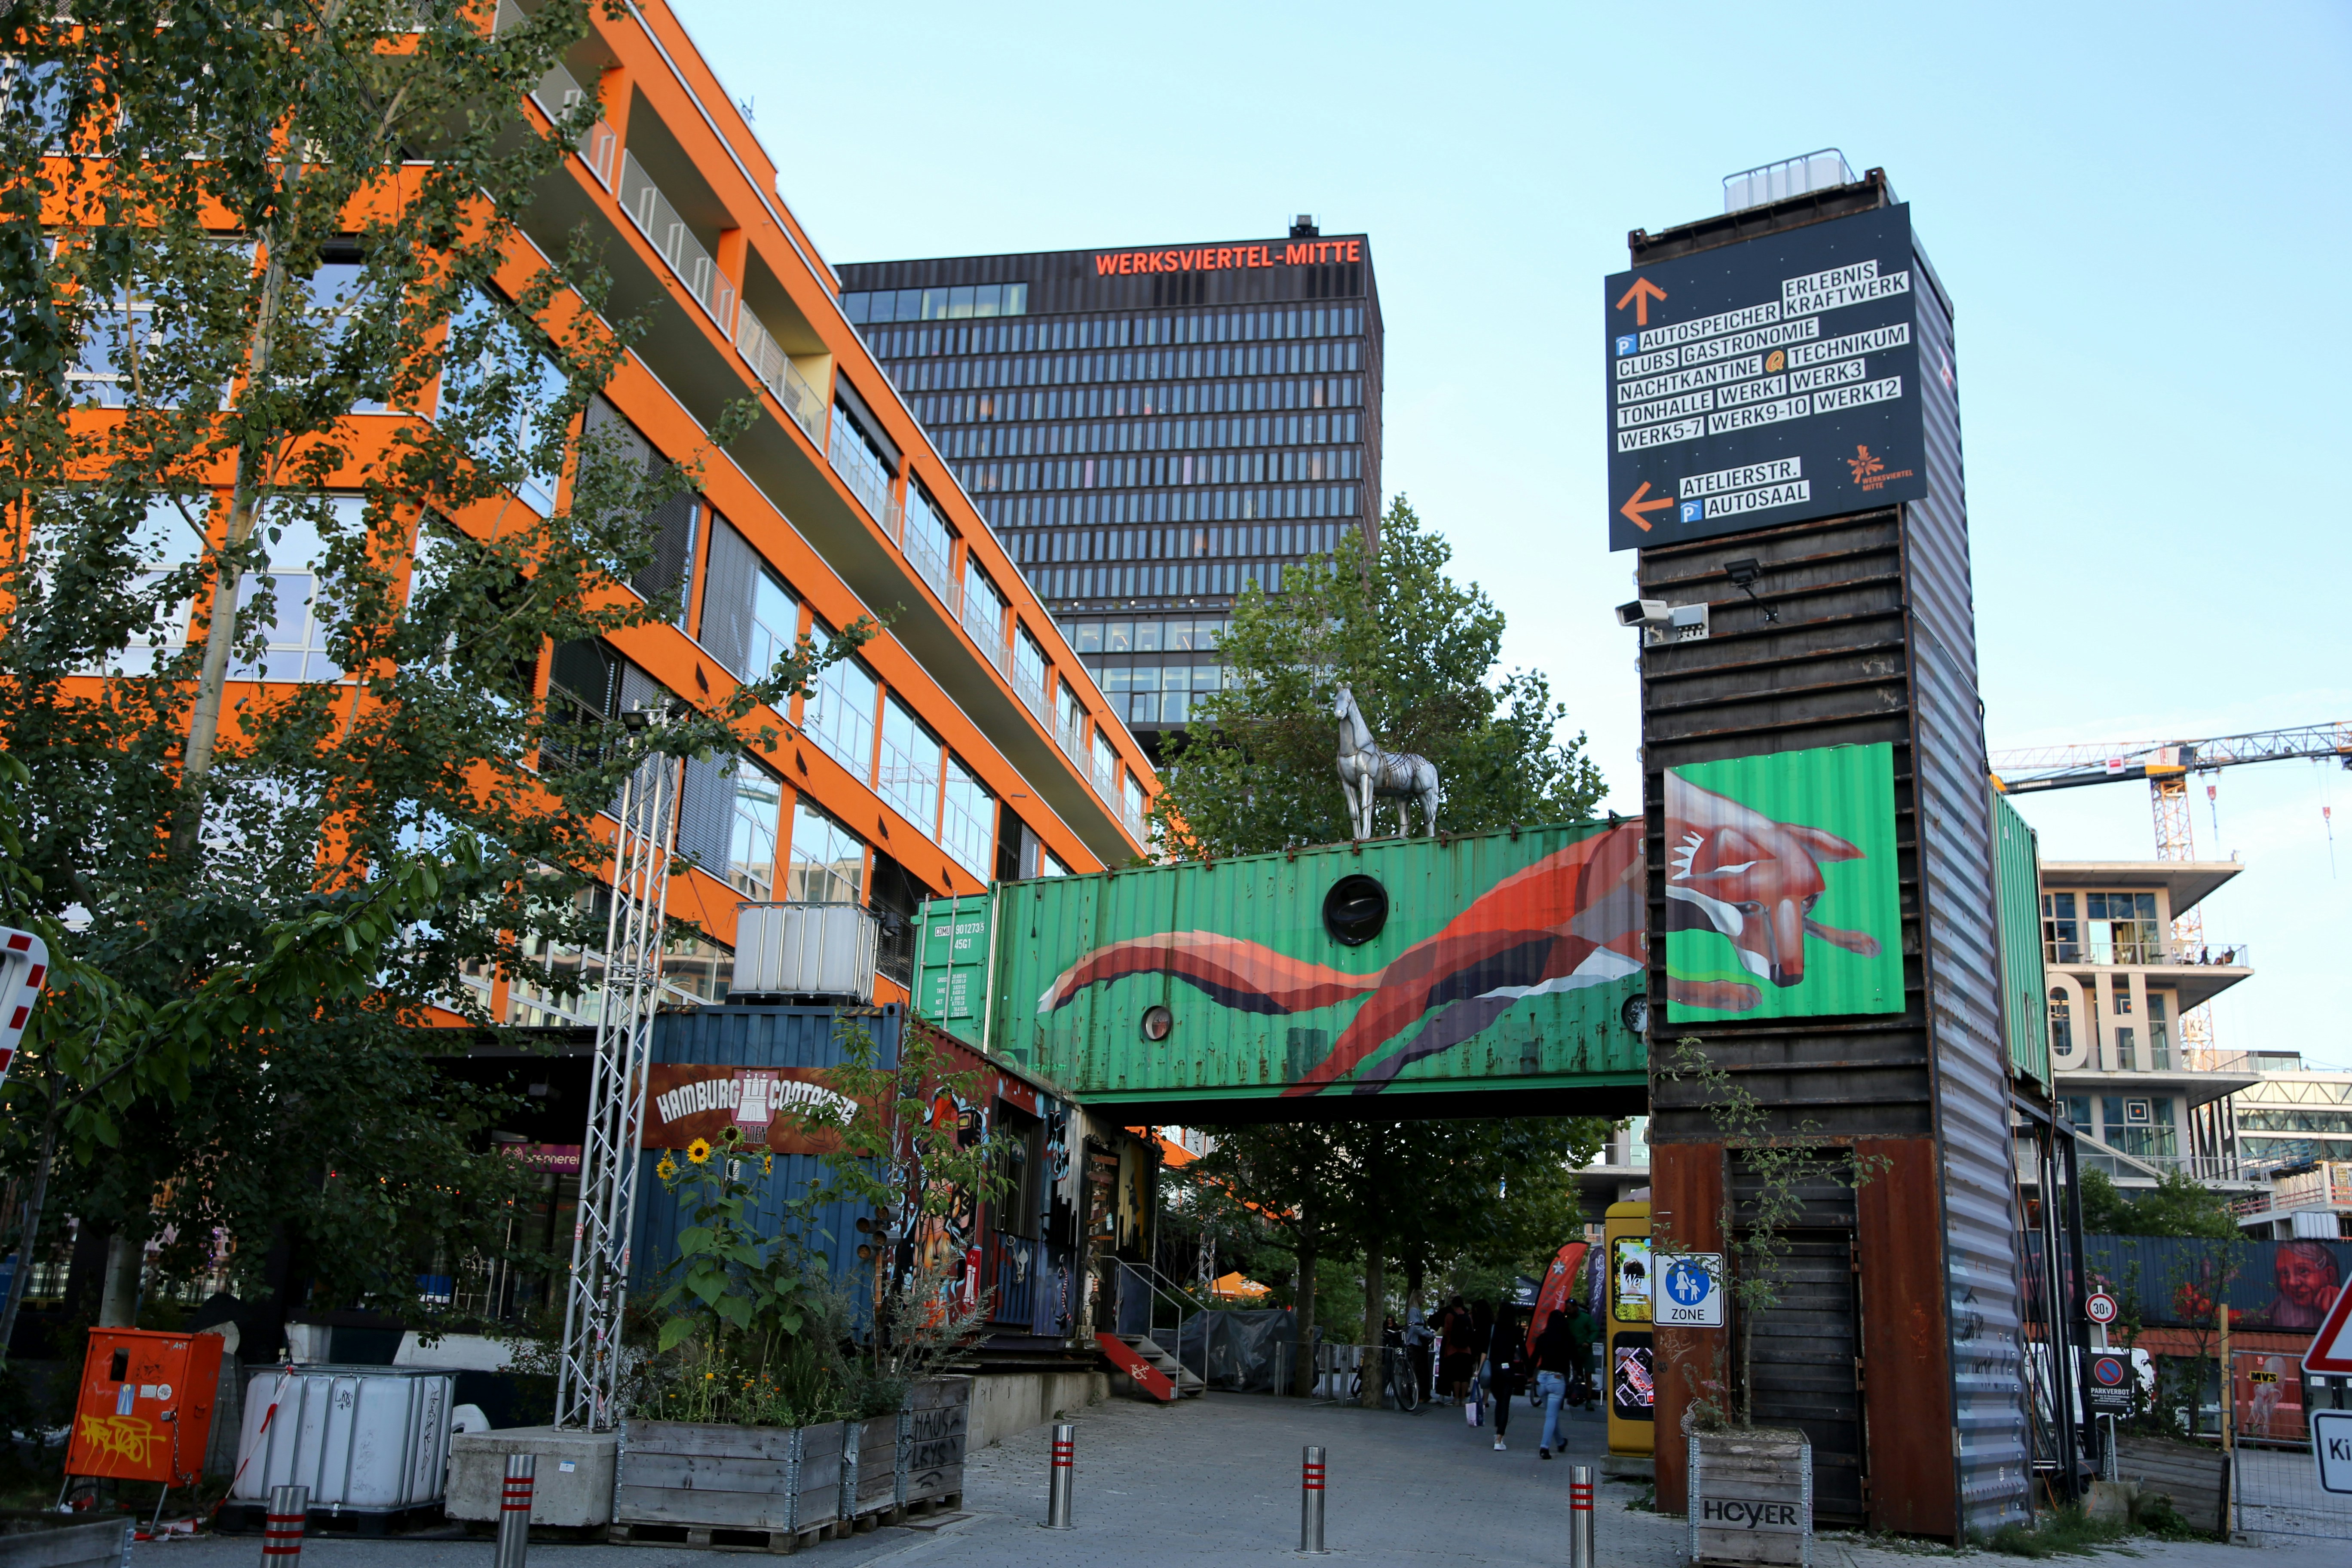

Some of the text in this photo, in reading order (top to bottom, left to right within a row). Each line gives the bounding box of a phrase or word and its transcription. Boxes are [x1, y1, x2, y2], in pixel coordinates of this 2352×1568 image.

[1096, 241, 1360, 275] WERKSVIERTEL-MITTE
[1787, 263, 1874, 297] ERLEBNIS
[1787, 274, 1905, 315] KRAFTWERK
[1642, 305, 1776, 348] AUTOSPEICHER
[1620, 320, 1814, 376] CLUBS GASTRONOMIE
[1621, 358, 1758, 401] NACHTKANTINE
[1791, 327, 1904, 364] TECHNIKUM
[1620, 362, 1861, 424] TONHALLE WERK1 WERK3
[1621, 380, 1897, 448] WERK5-7 WERK9-10 WERK12
[1684, 461, 1797, 495] ATELIERSTR.
[1862, 469, 1913, 484] WERKSVIERTEL
[1862, 482, 1884, 491] MITTE
[1709, 483, 1807, 515] AUTOSAAL
[954, 938, 971, 949] 45G1
[656, 1078, 740, 1124] HAMBURG
[738, 1125, 767, 1143] ADEN
[1671, 1309, 1705, 1320] ZONE
[2251, 1372, 2277, 1382] MVS
[915, 1409, 950, 1442] HAUS
[2328, 1437, 2352, 1461] Ki
[1704, 1500, 1798, 1529] HOYER
